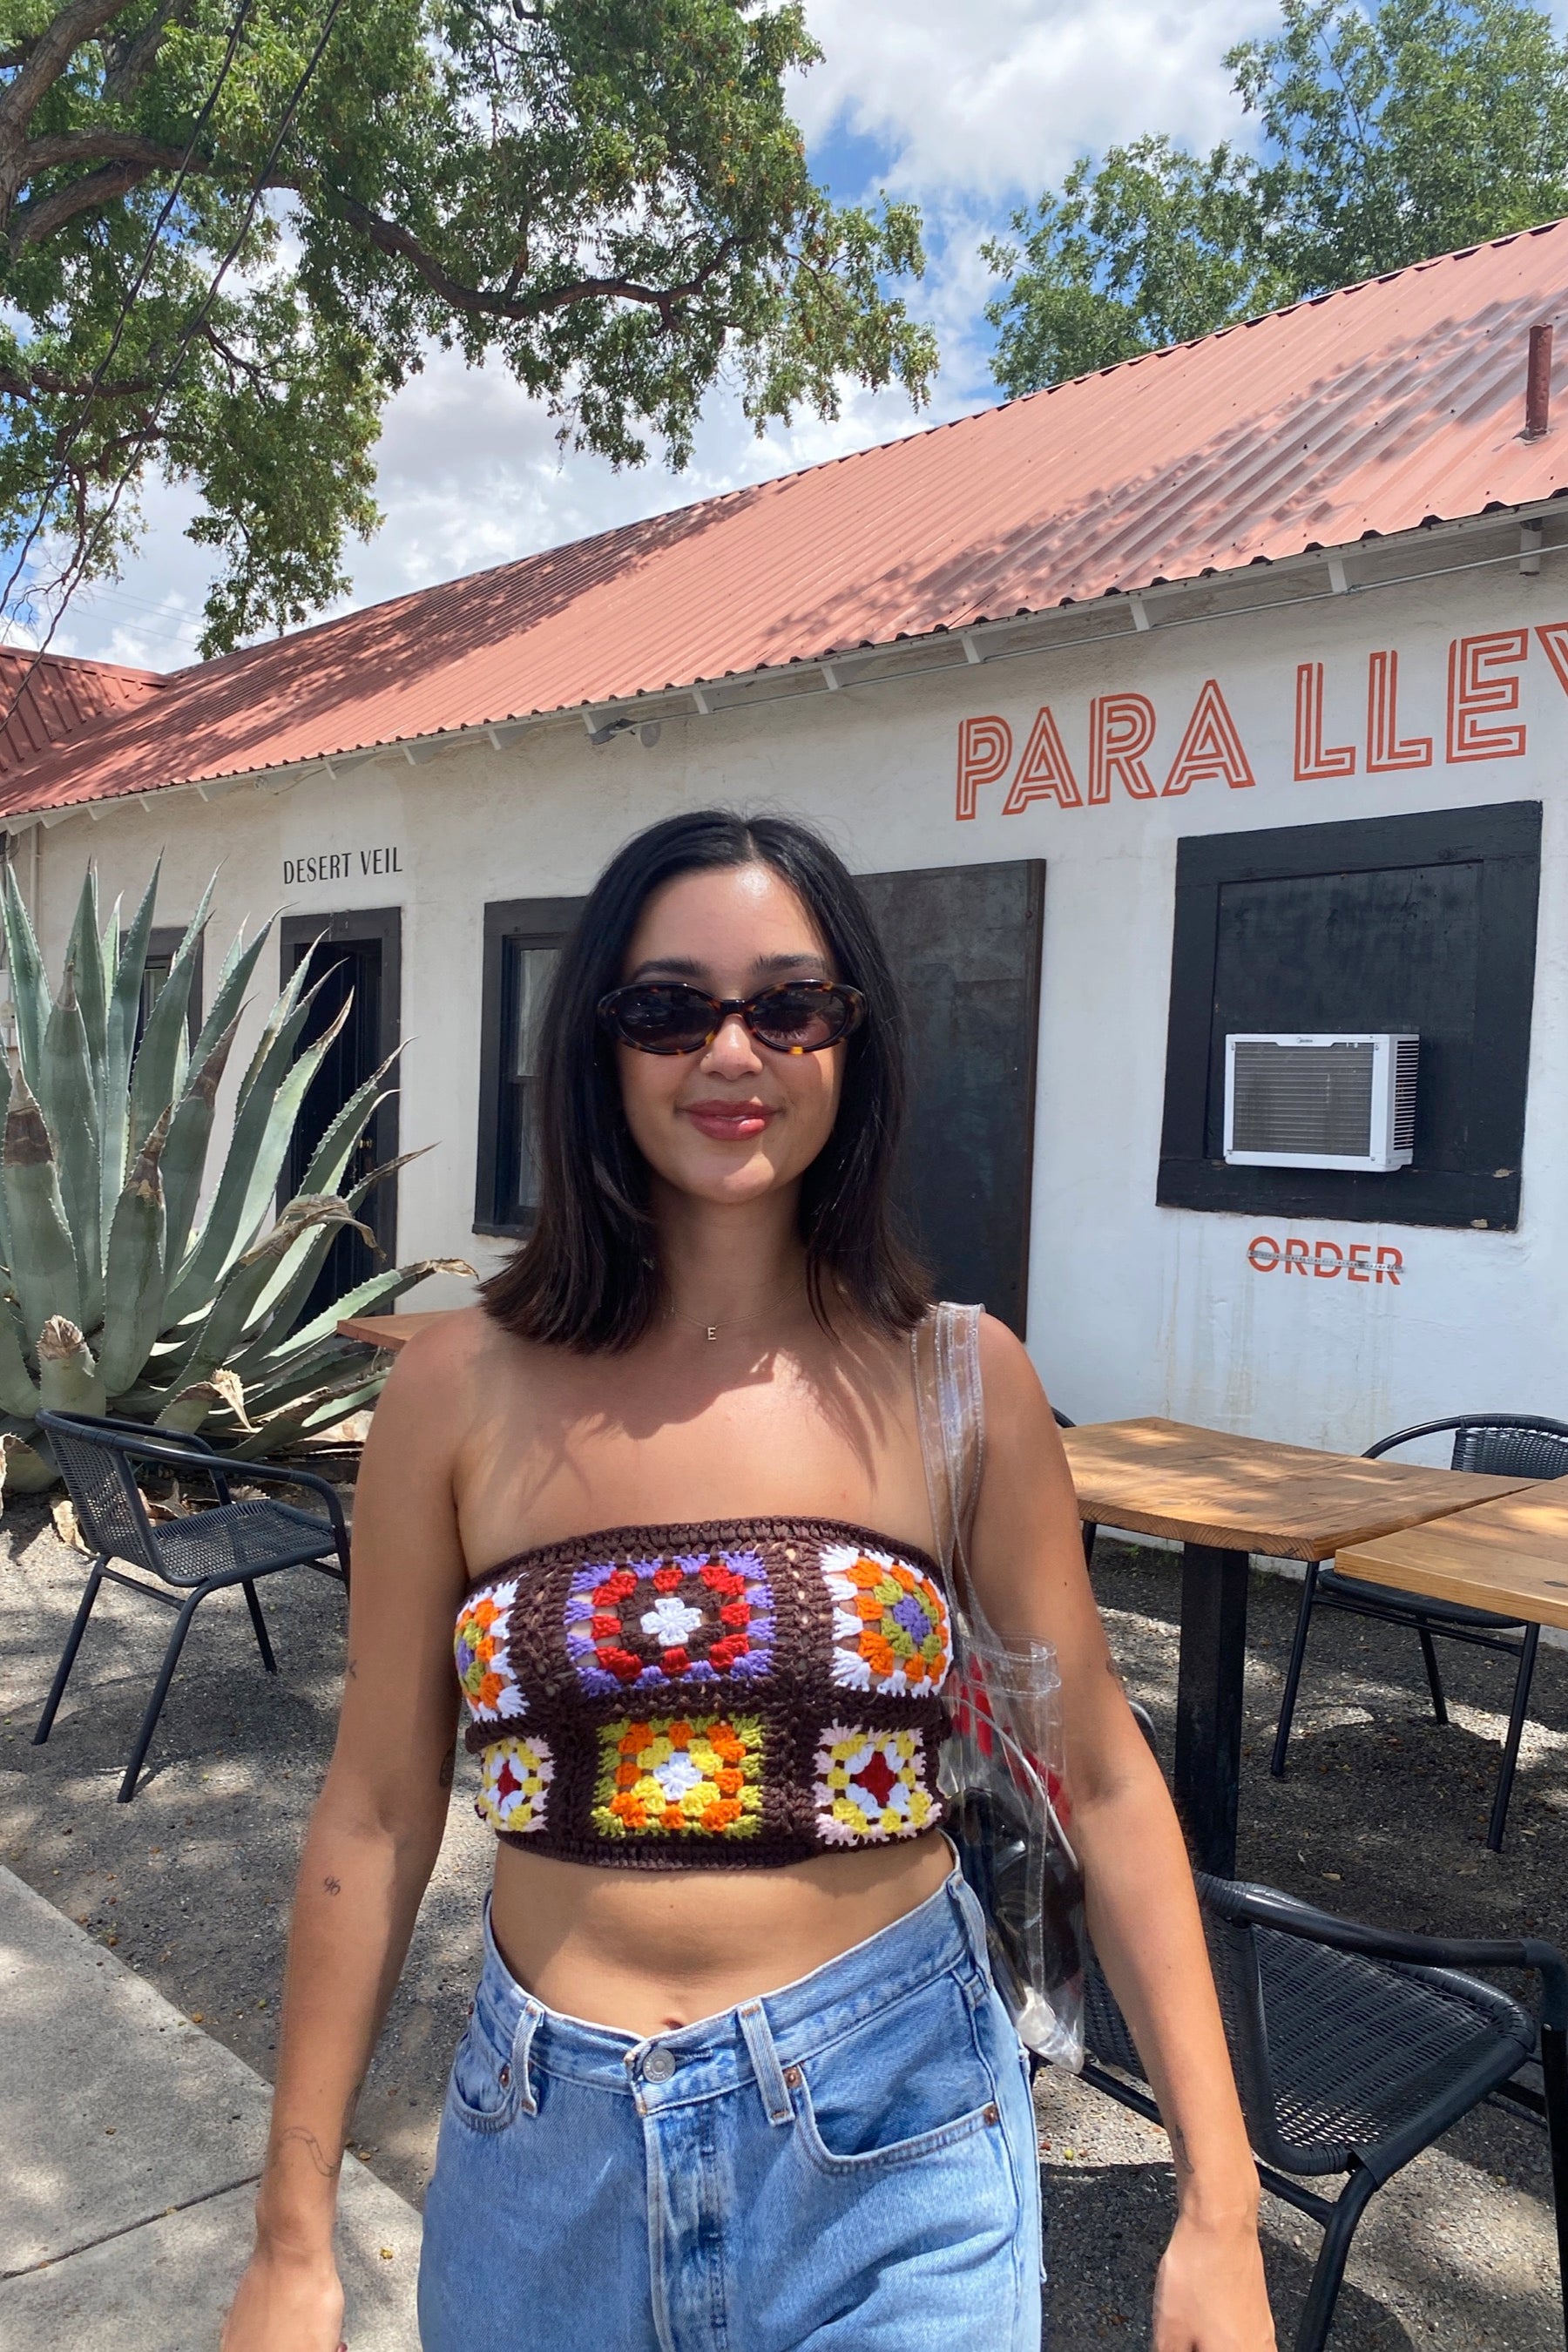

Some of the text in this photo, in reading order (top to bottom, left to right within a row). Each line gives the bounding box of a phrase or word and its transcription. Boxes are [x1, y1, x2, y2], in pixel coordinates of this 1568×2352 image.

[956, 679, 1256, 821] PARA
[284, 847, 402, 884] DESERT VEIL
[1247, 1236, 1403, 1286] ORDER
[707, 1327, 717, 1341] E
